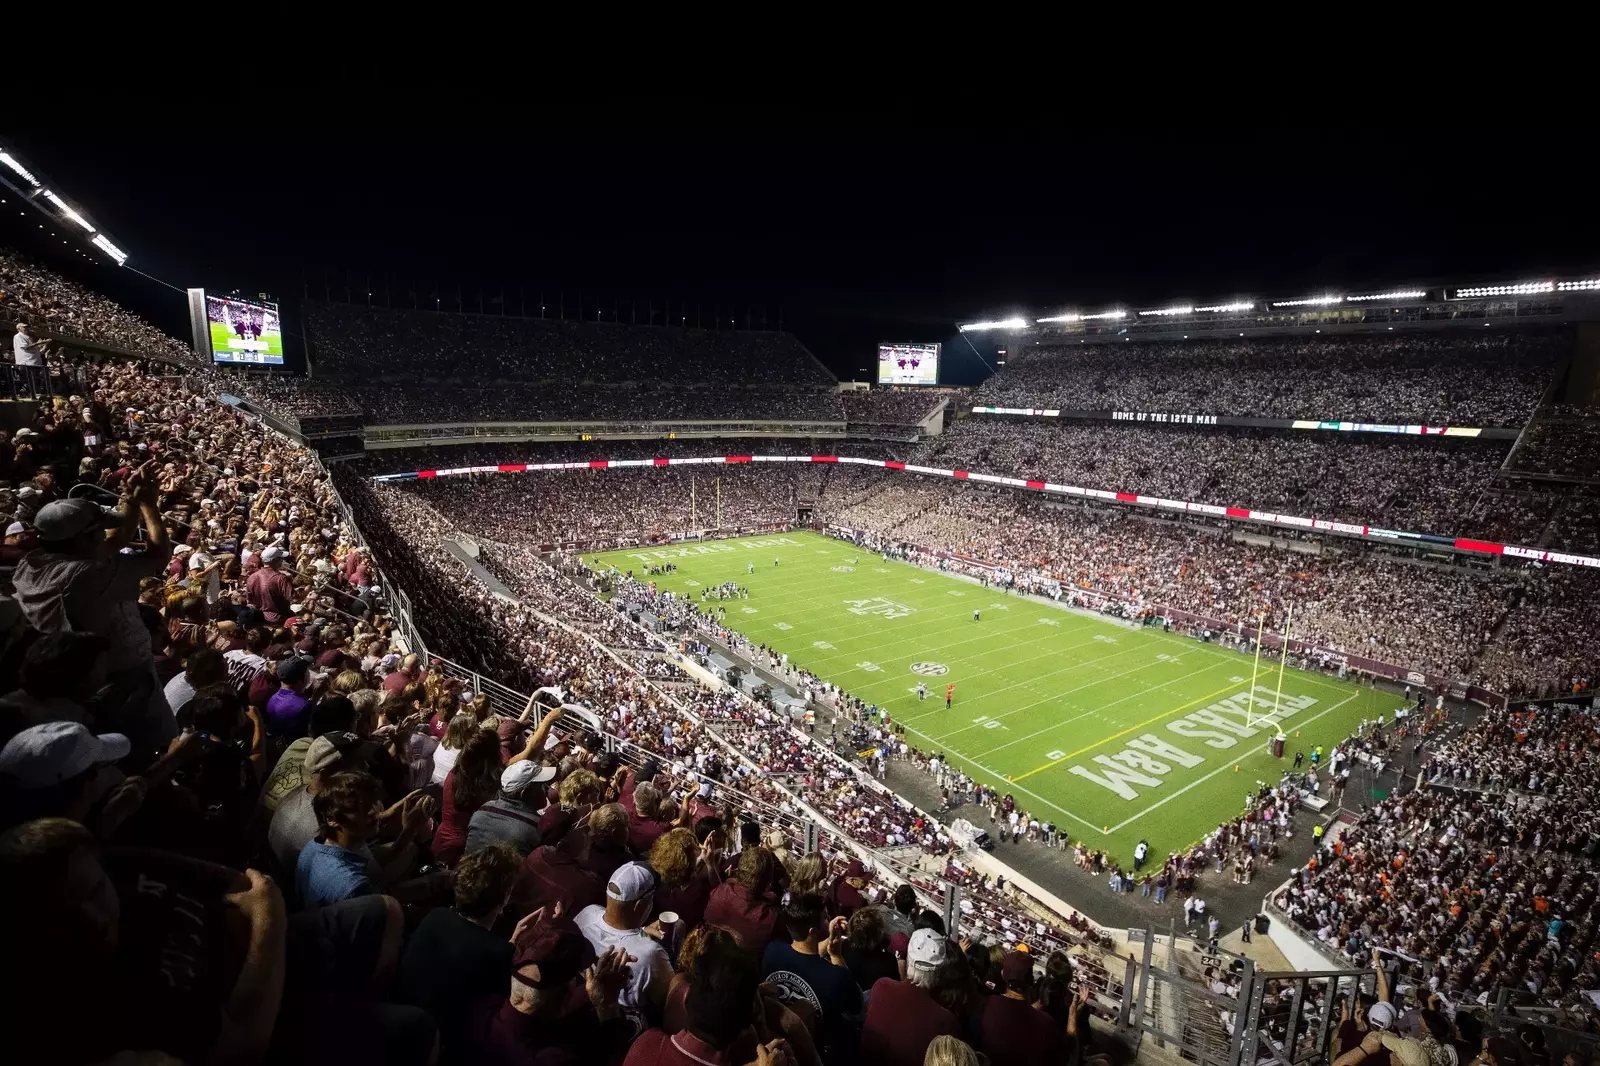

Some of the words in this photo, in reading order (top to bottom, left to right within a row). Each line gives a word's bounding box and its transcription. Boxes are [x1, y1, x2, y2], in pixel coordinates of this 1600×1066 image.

[1112, 411, 1135, 420] HOME
[1136, 413, 1147, 421] OF
[1150, 413, 1168, 422] THE
[1170, 414, 1193, 423] 12TH
[1196, 415, 1218, 425] MAN
[625, 542, 736, 564] TEXAS
[1165, 684, 1320, 749] TEXAS
[1067, 733, 1206, 801] A&M
